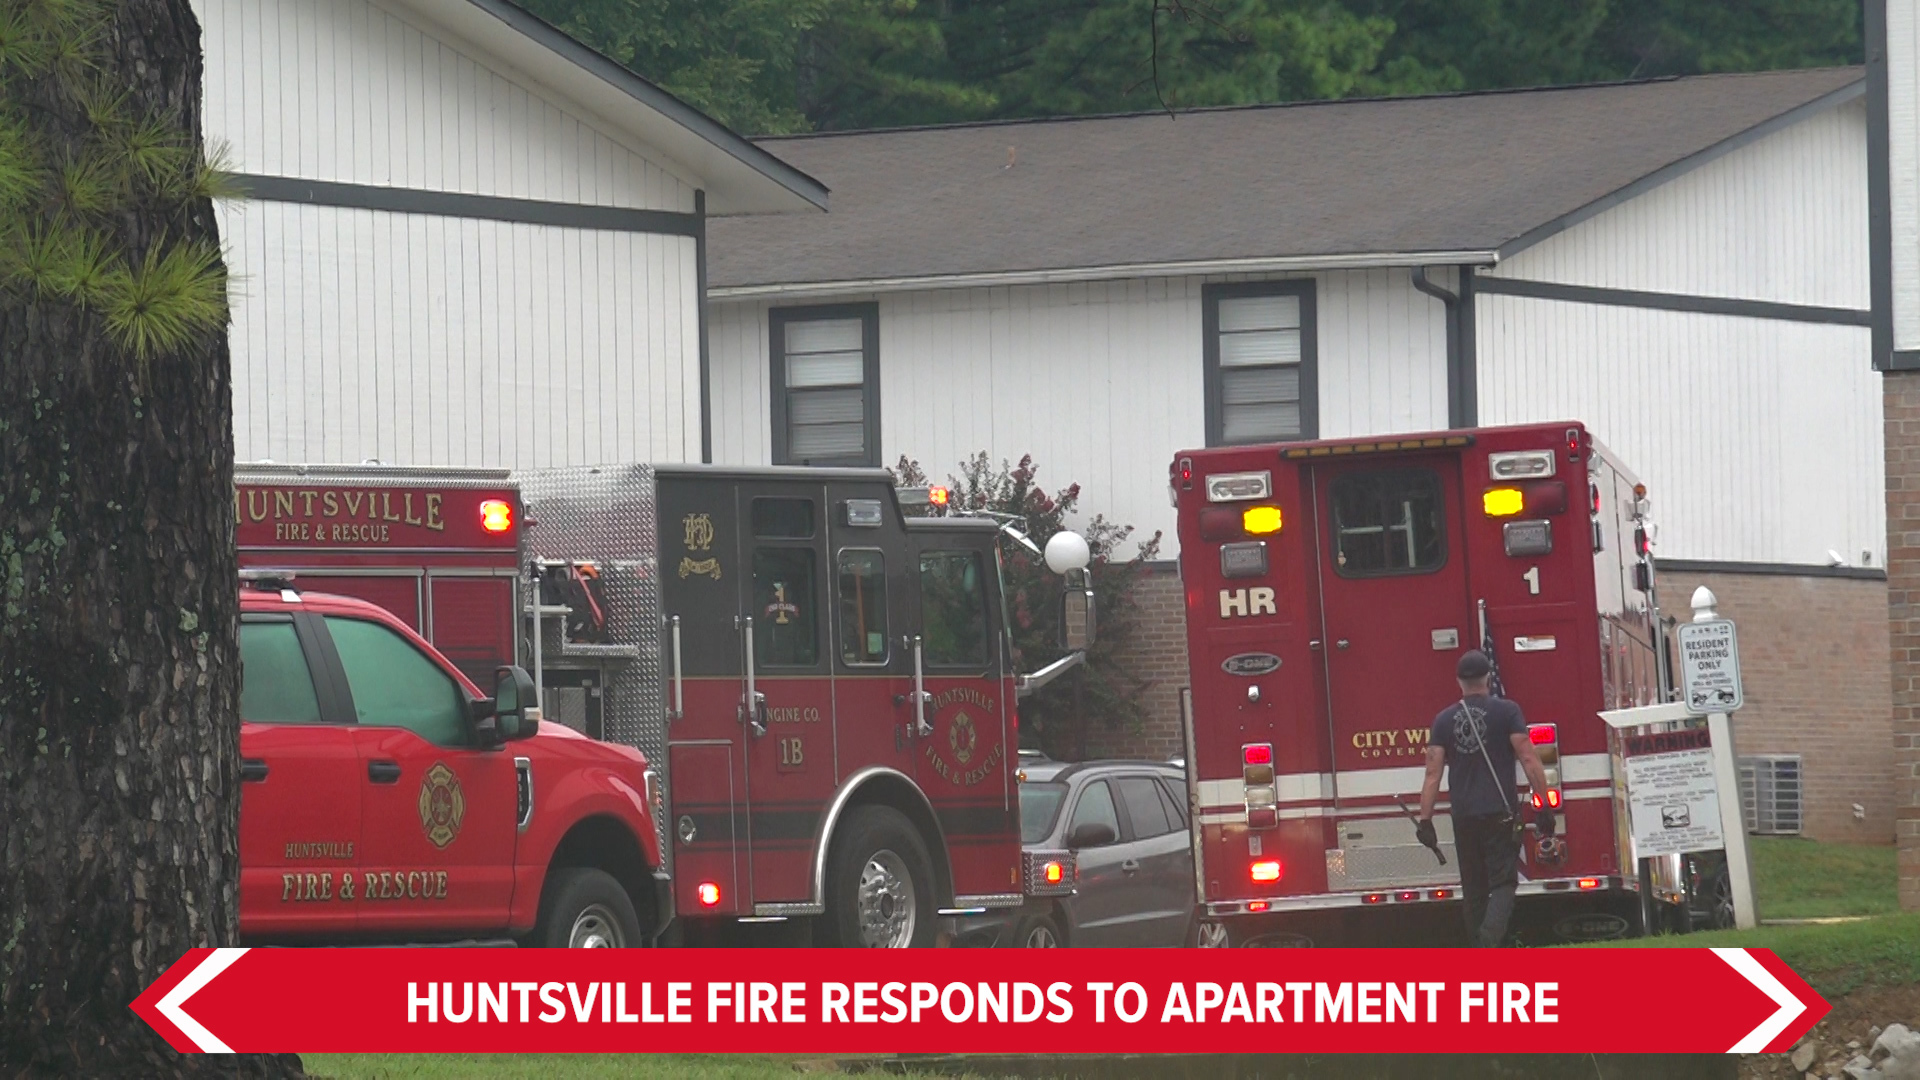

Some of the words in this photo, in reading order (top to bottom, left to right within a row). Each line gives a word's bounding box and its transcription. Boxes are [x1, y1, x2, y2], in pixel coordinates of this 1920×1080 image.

[276, 523, 310, 540] FIRE
[315, 523, 325, 541] &
[332, 523, 390, 542] RESCUE
[1523, 566, 1540, 594] 1
[1219, 586, 1277, 618] HR
[1685, 637, 1729, 650] RESIDENT
[1688, 649, 1729, 660] PARKING
[1697, 660, 1721, 670] ONLY
[766, 707, 801, 722] NGINE
[803, 707, 822, 722] CO.
[1352, 729, 1399, 748] CITY
[1630, 731, 1709, 756] WARNING
[780, 738, 804, 765] 1B
[925, 745, 949, 780] FIRE
[952, 771, 960, 784] &
[965, 743, 1001, 785] RESCUE
[285, 843, 354, 858] HUNTSVILLE
[282, 872, 332, 900] FIRE
[340, 872, 355, 899] &
[365, 871, 448, 899] RESCUE
